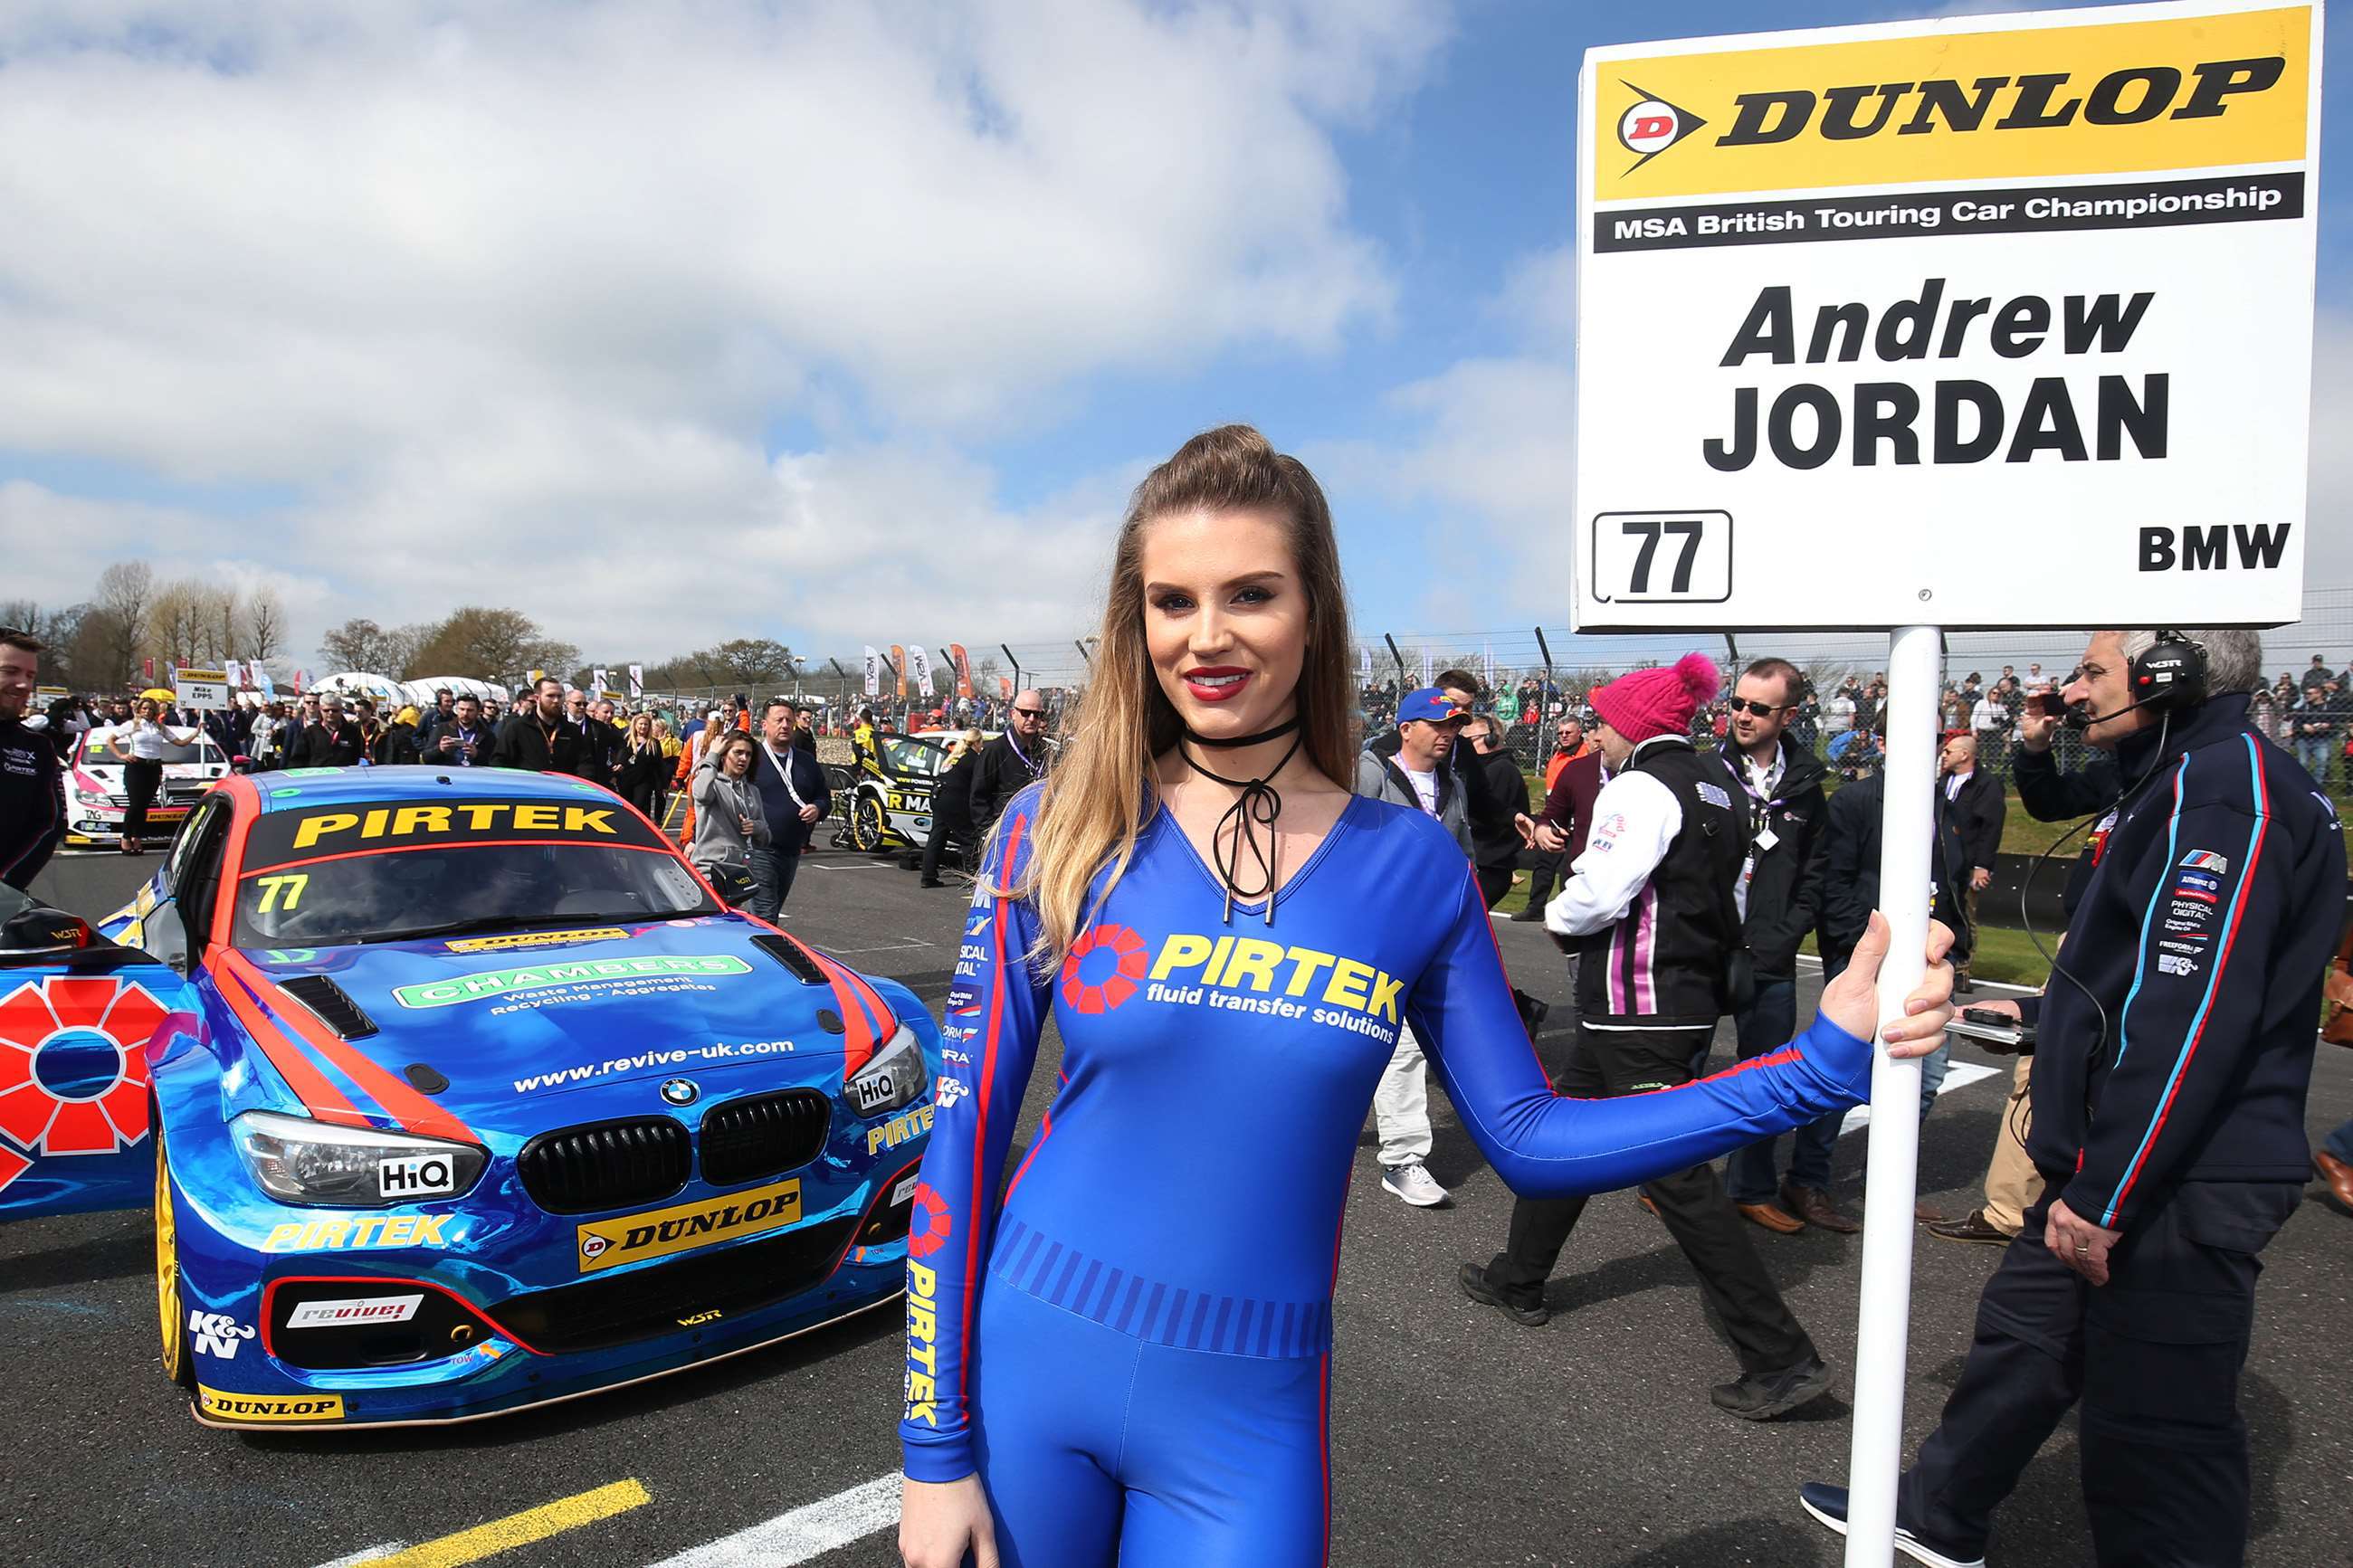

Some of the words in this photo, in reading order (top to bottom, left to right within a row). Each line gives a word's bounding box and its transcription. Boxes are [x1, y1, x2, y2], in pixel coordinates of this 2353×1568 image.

[1714, 56, 2286, 147] DUNLOP
[1614, 219, 1688, 241] MSA
[1697, 209, 1805, 235] British
[1814, 204, 1942, 233] Touring
[1951, 200, 2016, 223] Car
[2024, 185, 2283, 220] Championship
[1719, 278, 2157, 368] Andrew
[1702, 373, 2170, 473] JORDAN
[1622, 520, 1704, 594] 77
[2139, 522, 2291, 573] BMW
[2145, 659, 2182, 669] WSR
[291, 804, 618, 850] PIRTEK
[257, 874, 310, 914] 77
[2180, 875, 2209, 887] Allianz
[2171, 899, 2214, 916] PHYSICAL
[2172, 908, 2206, 921] DIGITAL
[50, 928, 81, 939] WSR
[485, 930, 624, 945] DUNLOP
[959, 945, 989, 962] SICAL
[420, 959, 731, 1002] CHAMBERS
[503, 987, 568, 1003] Waste
[572, 975, 694, 993] Management
[1148, 933, 1405, 1027] PIRTEK
[491, 993, 593, 1016] Recycling
[611, 983, 717, 997] Aggregates
[1146, 983, 1202, 1005] fluid
[1209, 990, 1307, 1020] transfer
[1311, 1008, 1396, 1046] solutions
[513, 1039, 795, 1094] www.revive-uk.com
[860, 1075, 894, 1105] HiQ
[867, 1103, 936, 1156] PIRTE
[383, 1160, 450, 1193] HiQ
[264, 1214, 455, 1250] PIRTEK
[620, 1191, 800, 1251] DUNLOP
[302, 1300, 406, 1320] revive!
[676, 1309, 723, 1327] WSR
[188, 1309, 256, 1360] K&N
[908, 1258, 938, 1429] PIRTEK
[450, 1354, 474, 1365] TOW
[216, 1400, 337, 1416] DUNLOP
